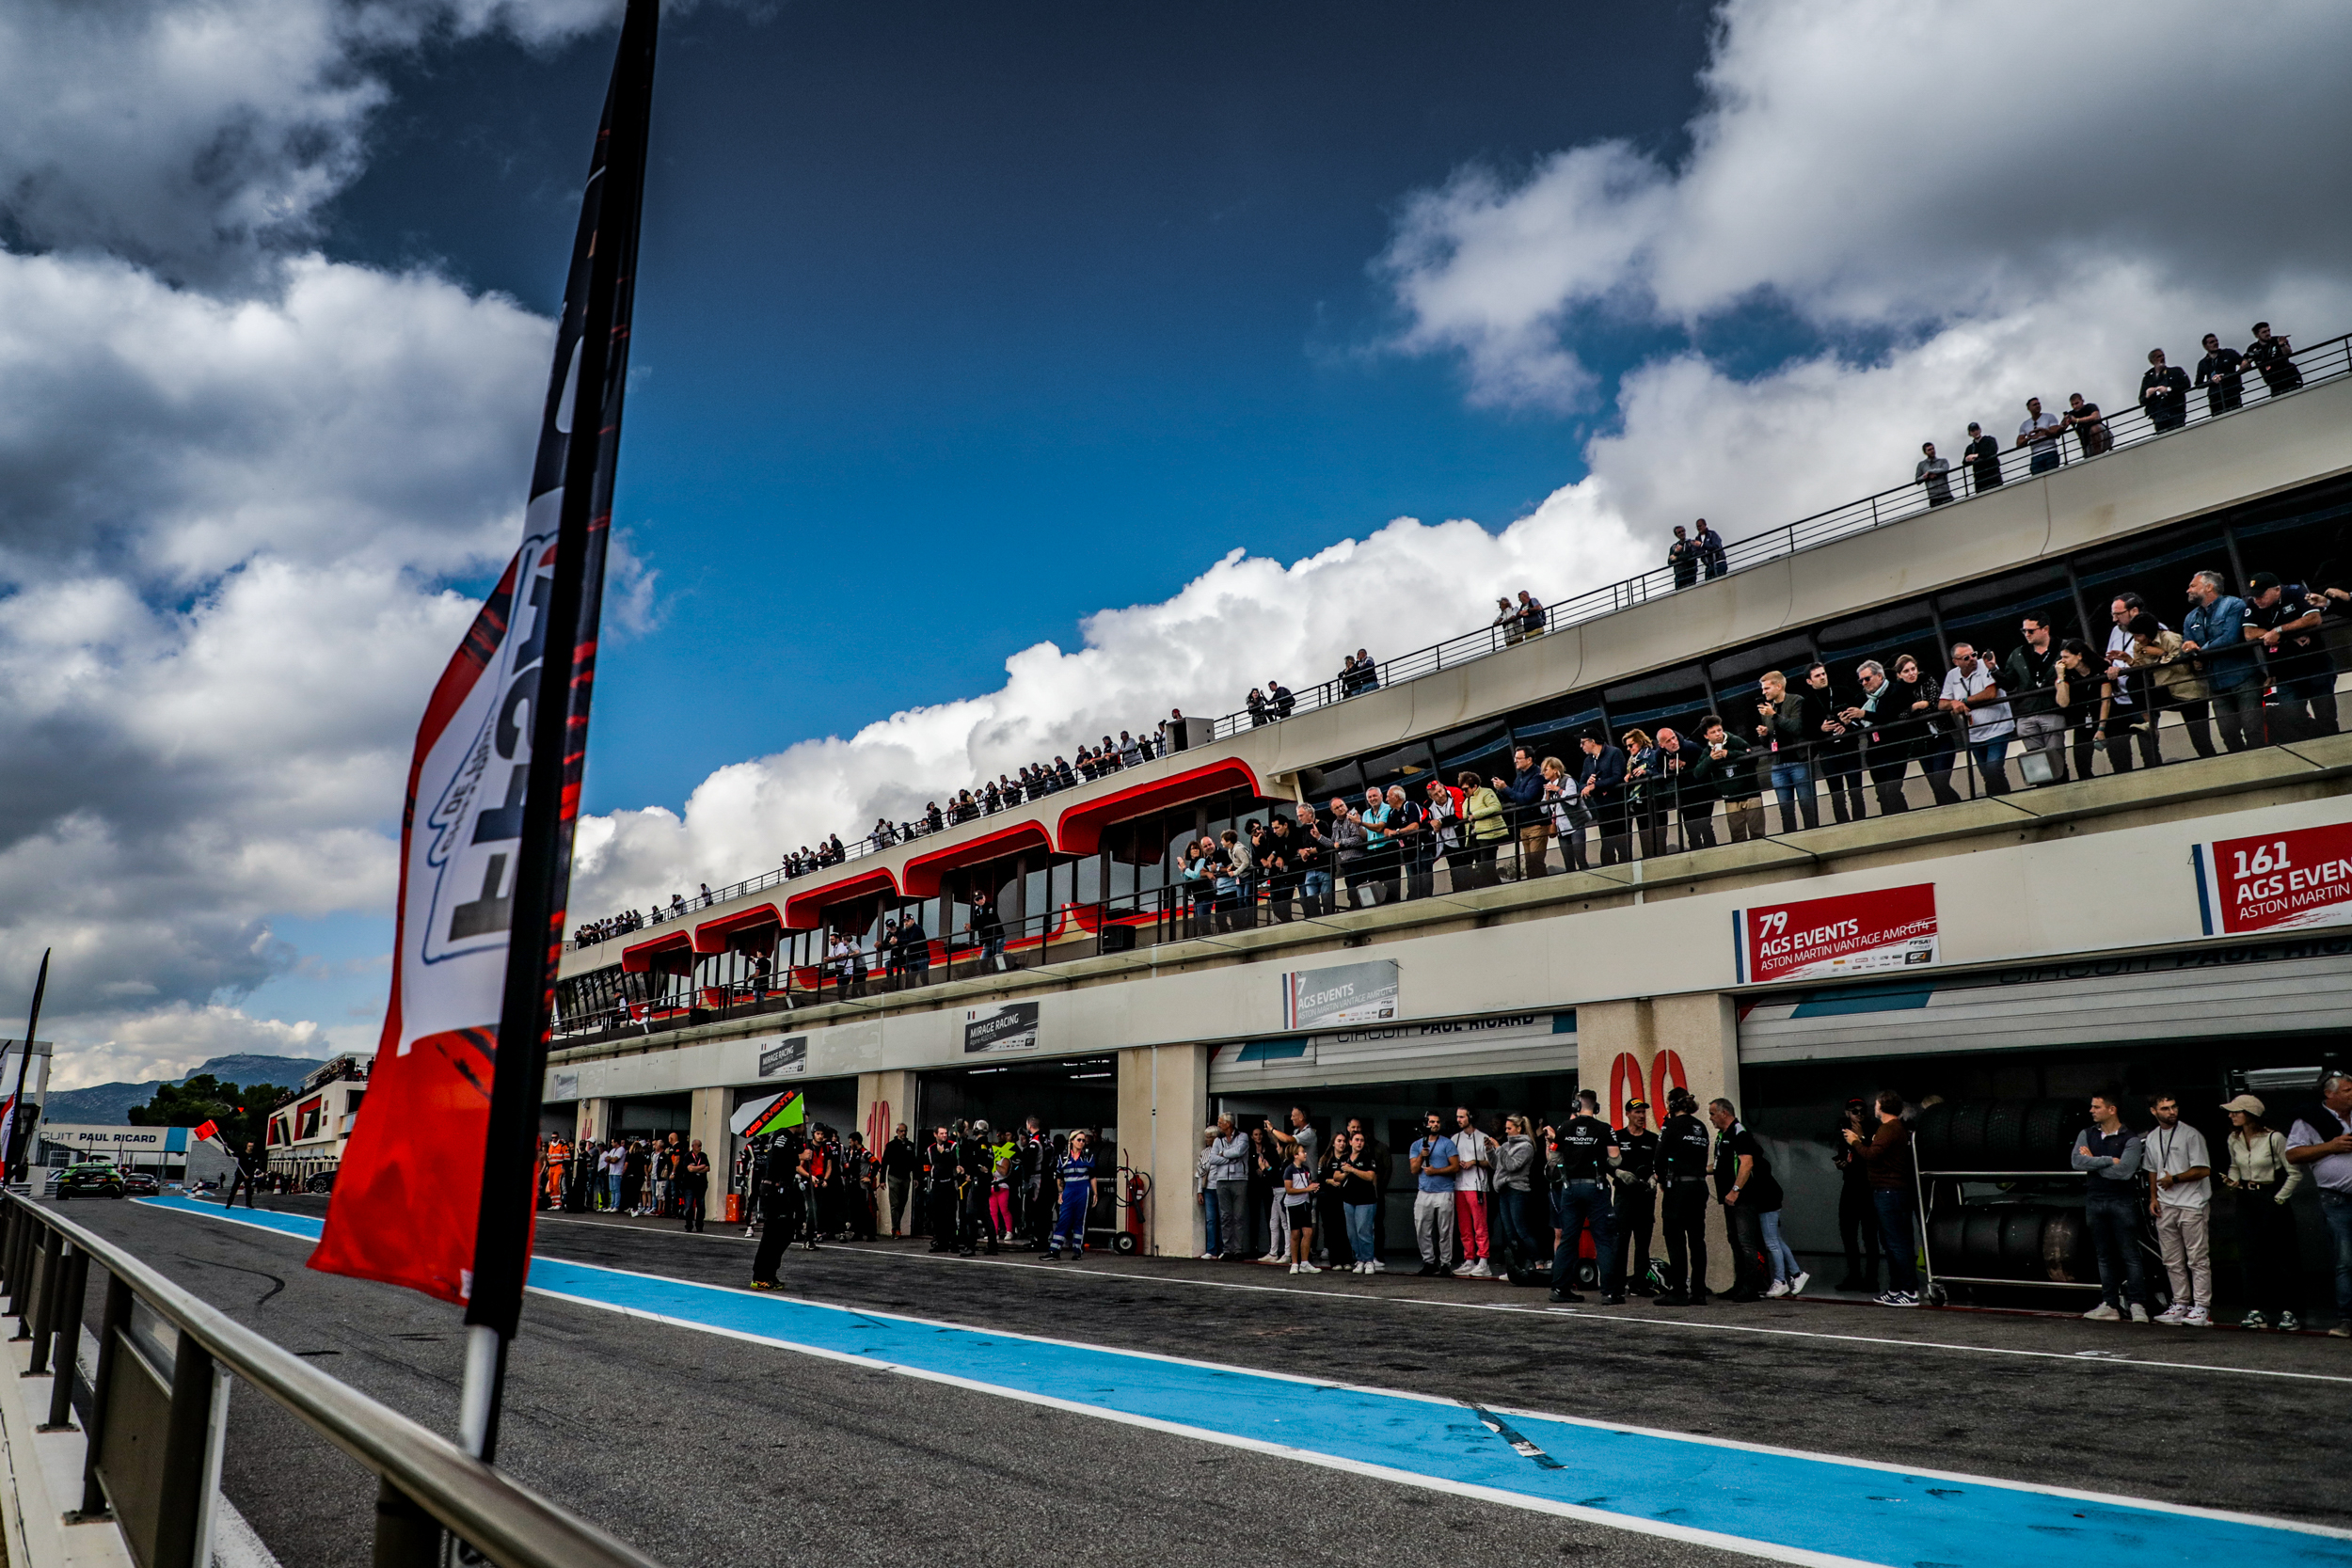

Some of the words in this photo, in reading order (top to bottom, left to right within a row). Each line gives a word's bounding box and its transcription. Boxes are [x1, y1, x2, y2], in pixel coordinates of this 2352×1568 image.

[2233, 841, 2291, 879] 161
[2236, 875, 2284, 904] AGS
[2239, 897, 2288, 920] ASTON
[2292, 882, 2350, 908] MARTIN
[1759, 911, 1788, 939] 79
[1759, 936, 1790, 958] AGS
[1794, 918, 1858, 950] EVENTS
[1761, 954, 1792, 972] ASTON
[1794, 944, 1833, 962] MARTIN
[1833, 931, 1881, 953] VANTAGE
[1883, 926, 1907, 942] AMR
[1908, 921, 1929, 935] GT4
[1297, 977, 1306, 995] 7
[1297, 994, 1315, 1010] AGS
[1317, 983, 1354, 1006] EVENTS
[1297, 1009, 1316, 1021] ASTON
[1317, 1002, 1339, 1014] MARTIN
[1339, 994, 1366, 1008] VANTAGE
[970, 1022, 994, 1038] MIRAGE
[995, 1013, 1019, 1030] RACING
[746, 1119, 763, 1138] AGS
[761, 1090, 794, 1122] EVENTS
[79, 1132, 108, 1142] PAUL
[113, 1134, 156, 1143] RICARD
[866, 1101, 890, 1164] 10
